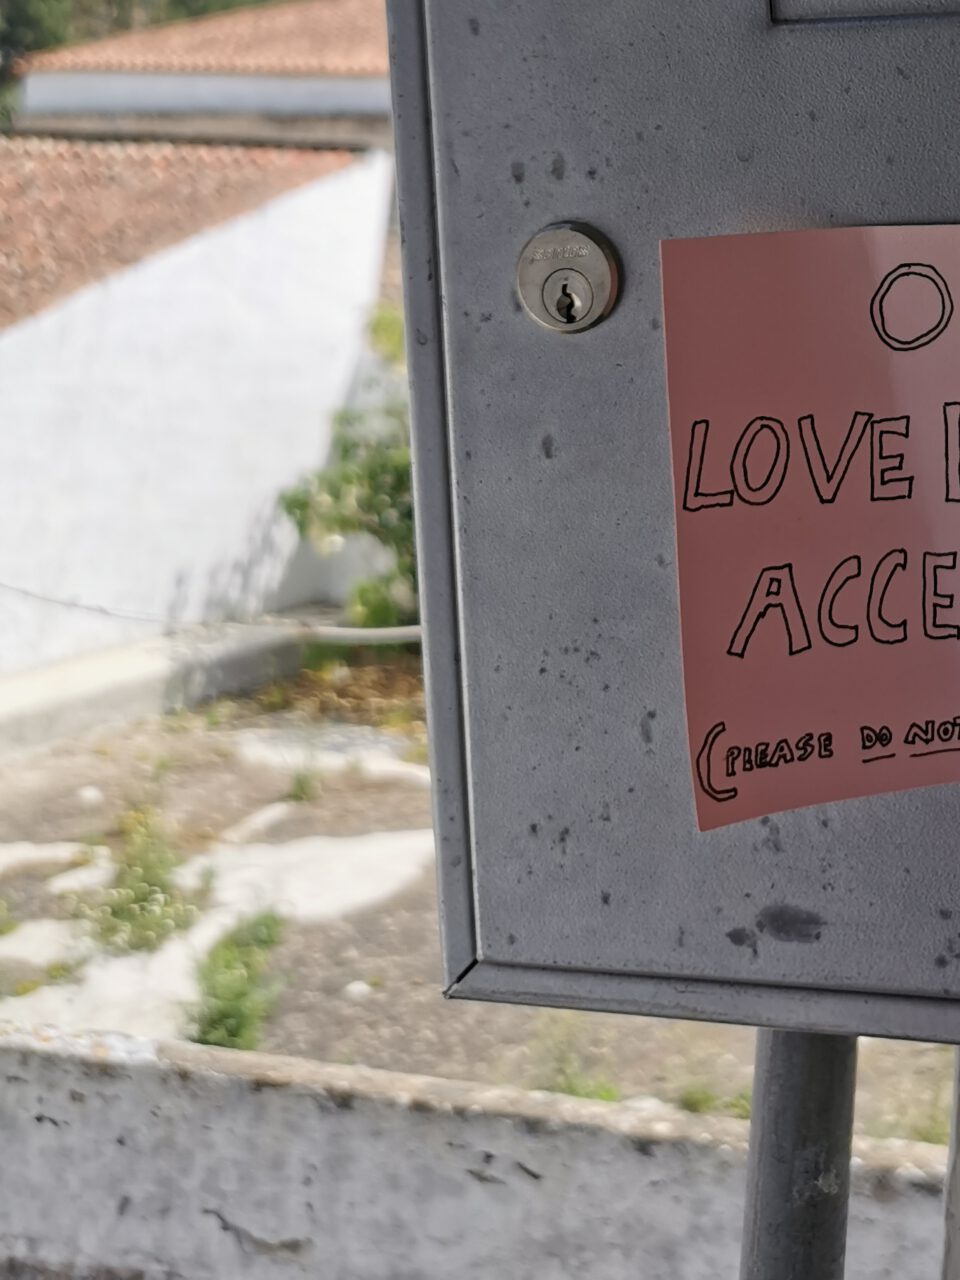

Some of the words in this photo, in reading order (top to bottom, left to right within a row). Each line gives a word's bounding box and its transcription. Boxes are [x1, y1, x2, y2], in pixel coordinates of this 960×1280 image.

[682, 412, 914, 511] LOVE
[696, 721, 833, 802] (PLEASE
[860, 726, 893, 750] DO
